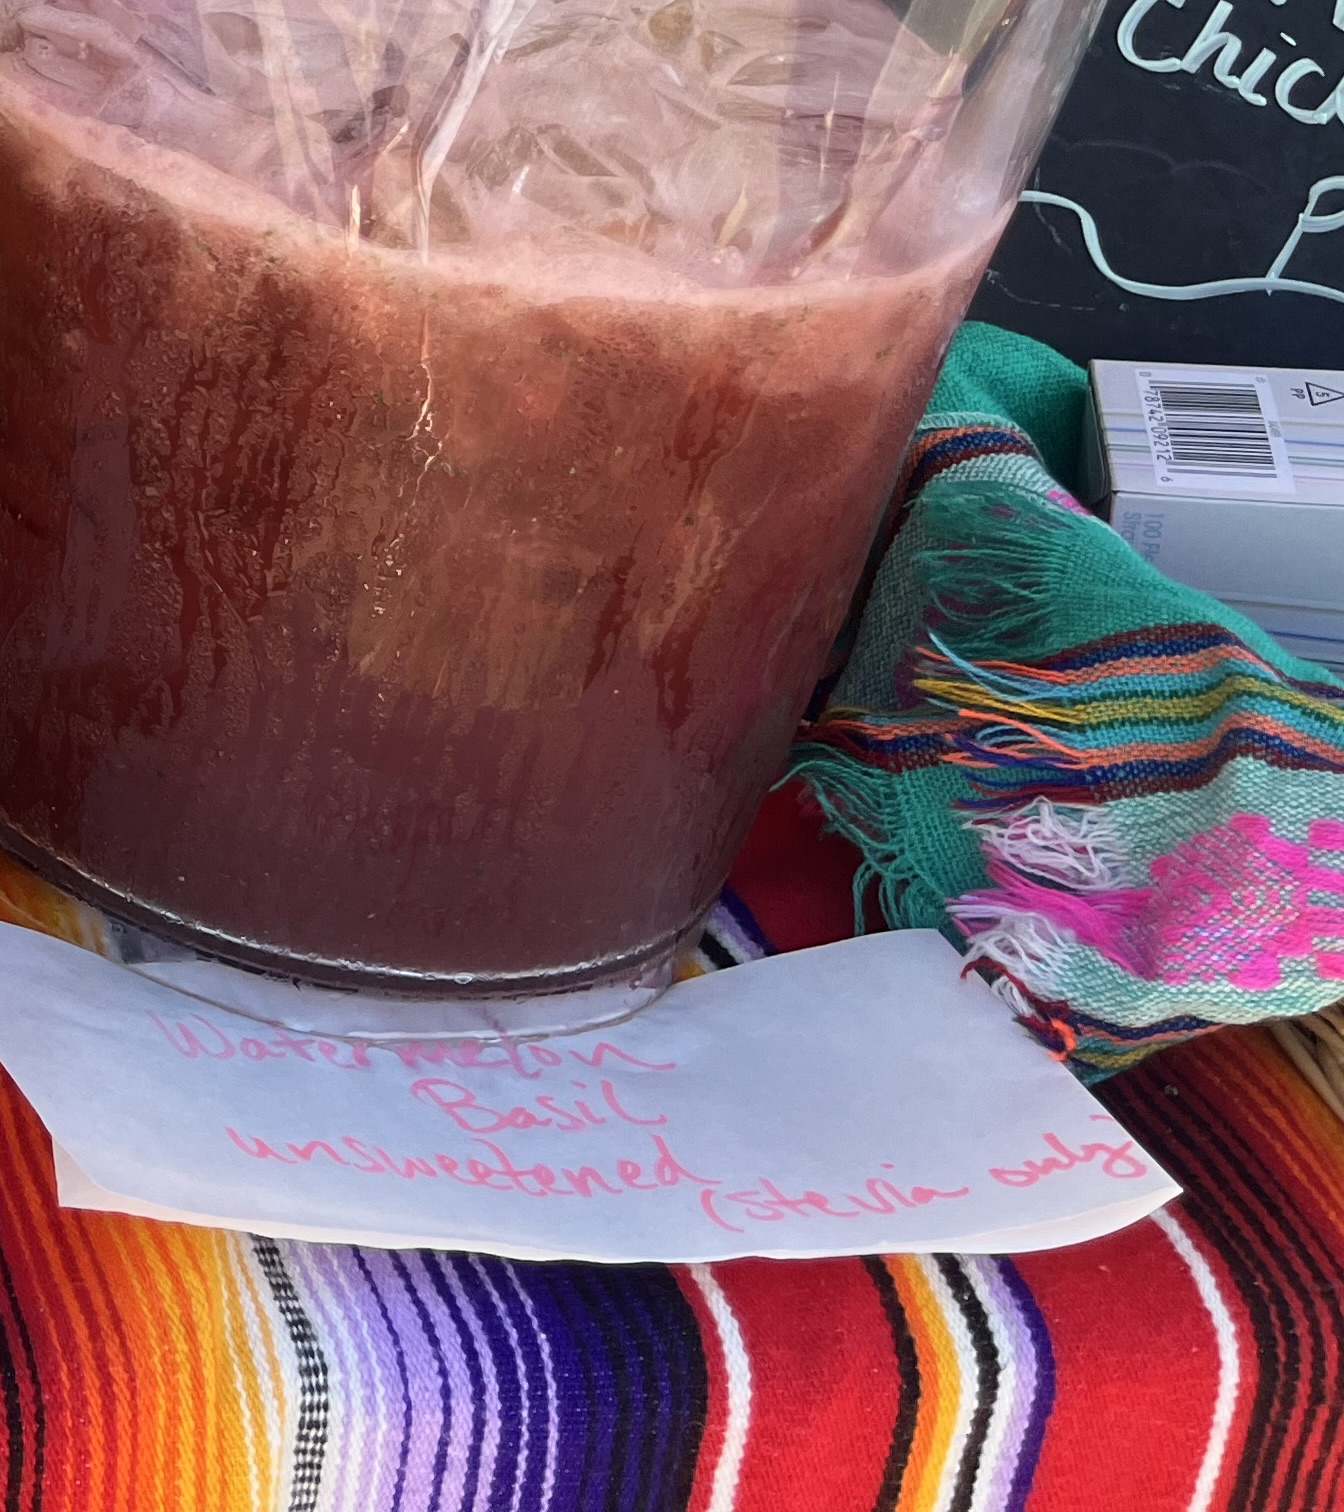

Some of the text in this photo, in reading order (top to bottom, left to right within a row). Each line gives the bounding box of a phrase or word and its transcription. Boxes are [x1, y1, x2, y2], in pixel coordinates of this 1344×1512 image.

[147, 1006, 677, 1080] Watermelon
[410, 1076, 669, 1134] Basil
[223, 1124, 723, 1198] unsweetened
